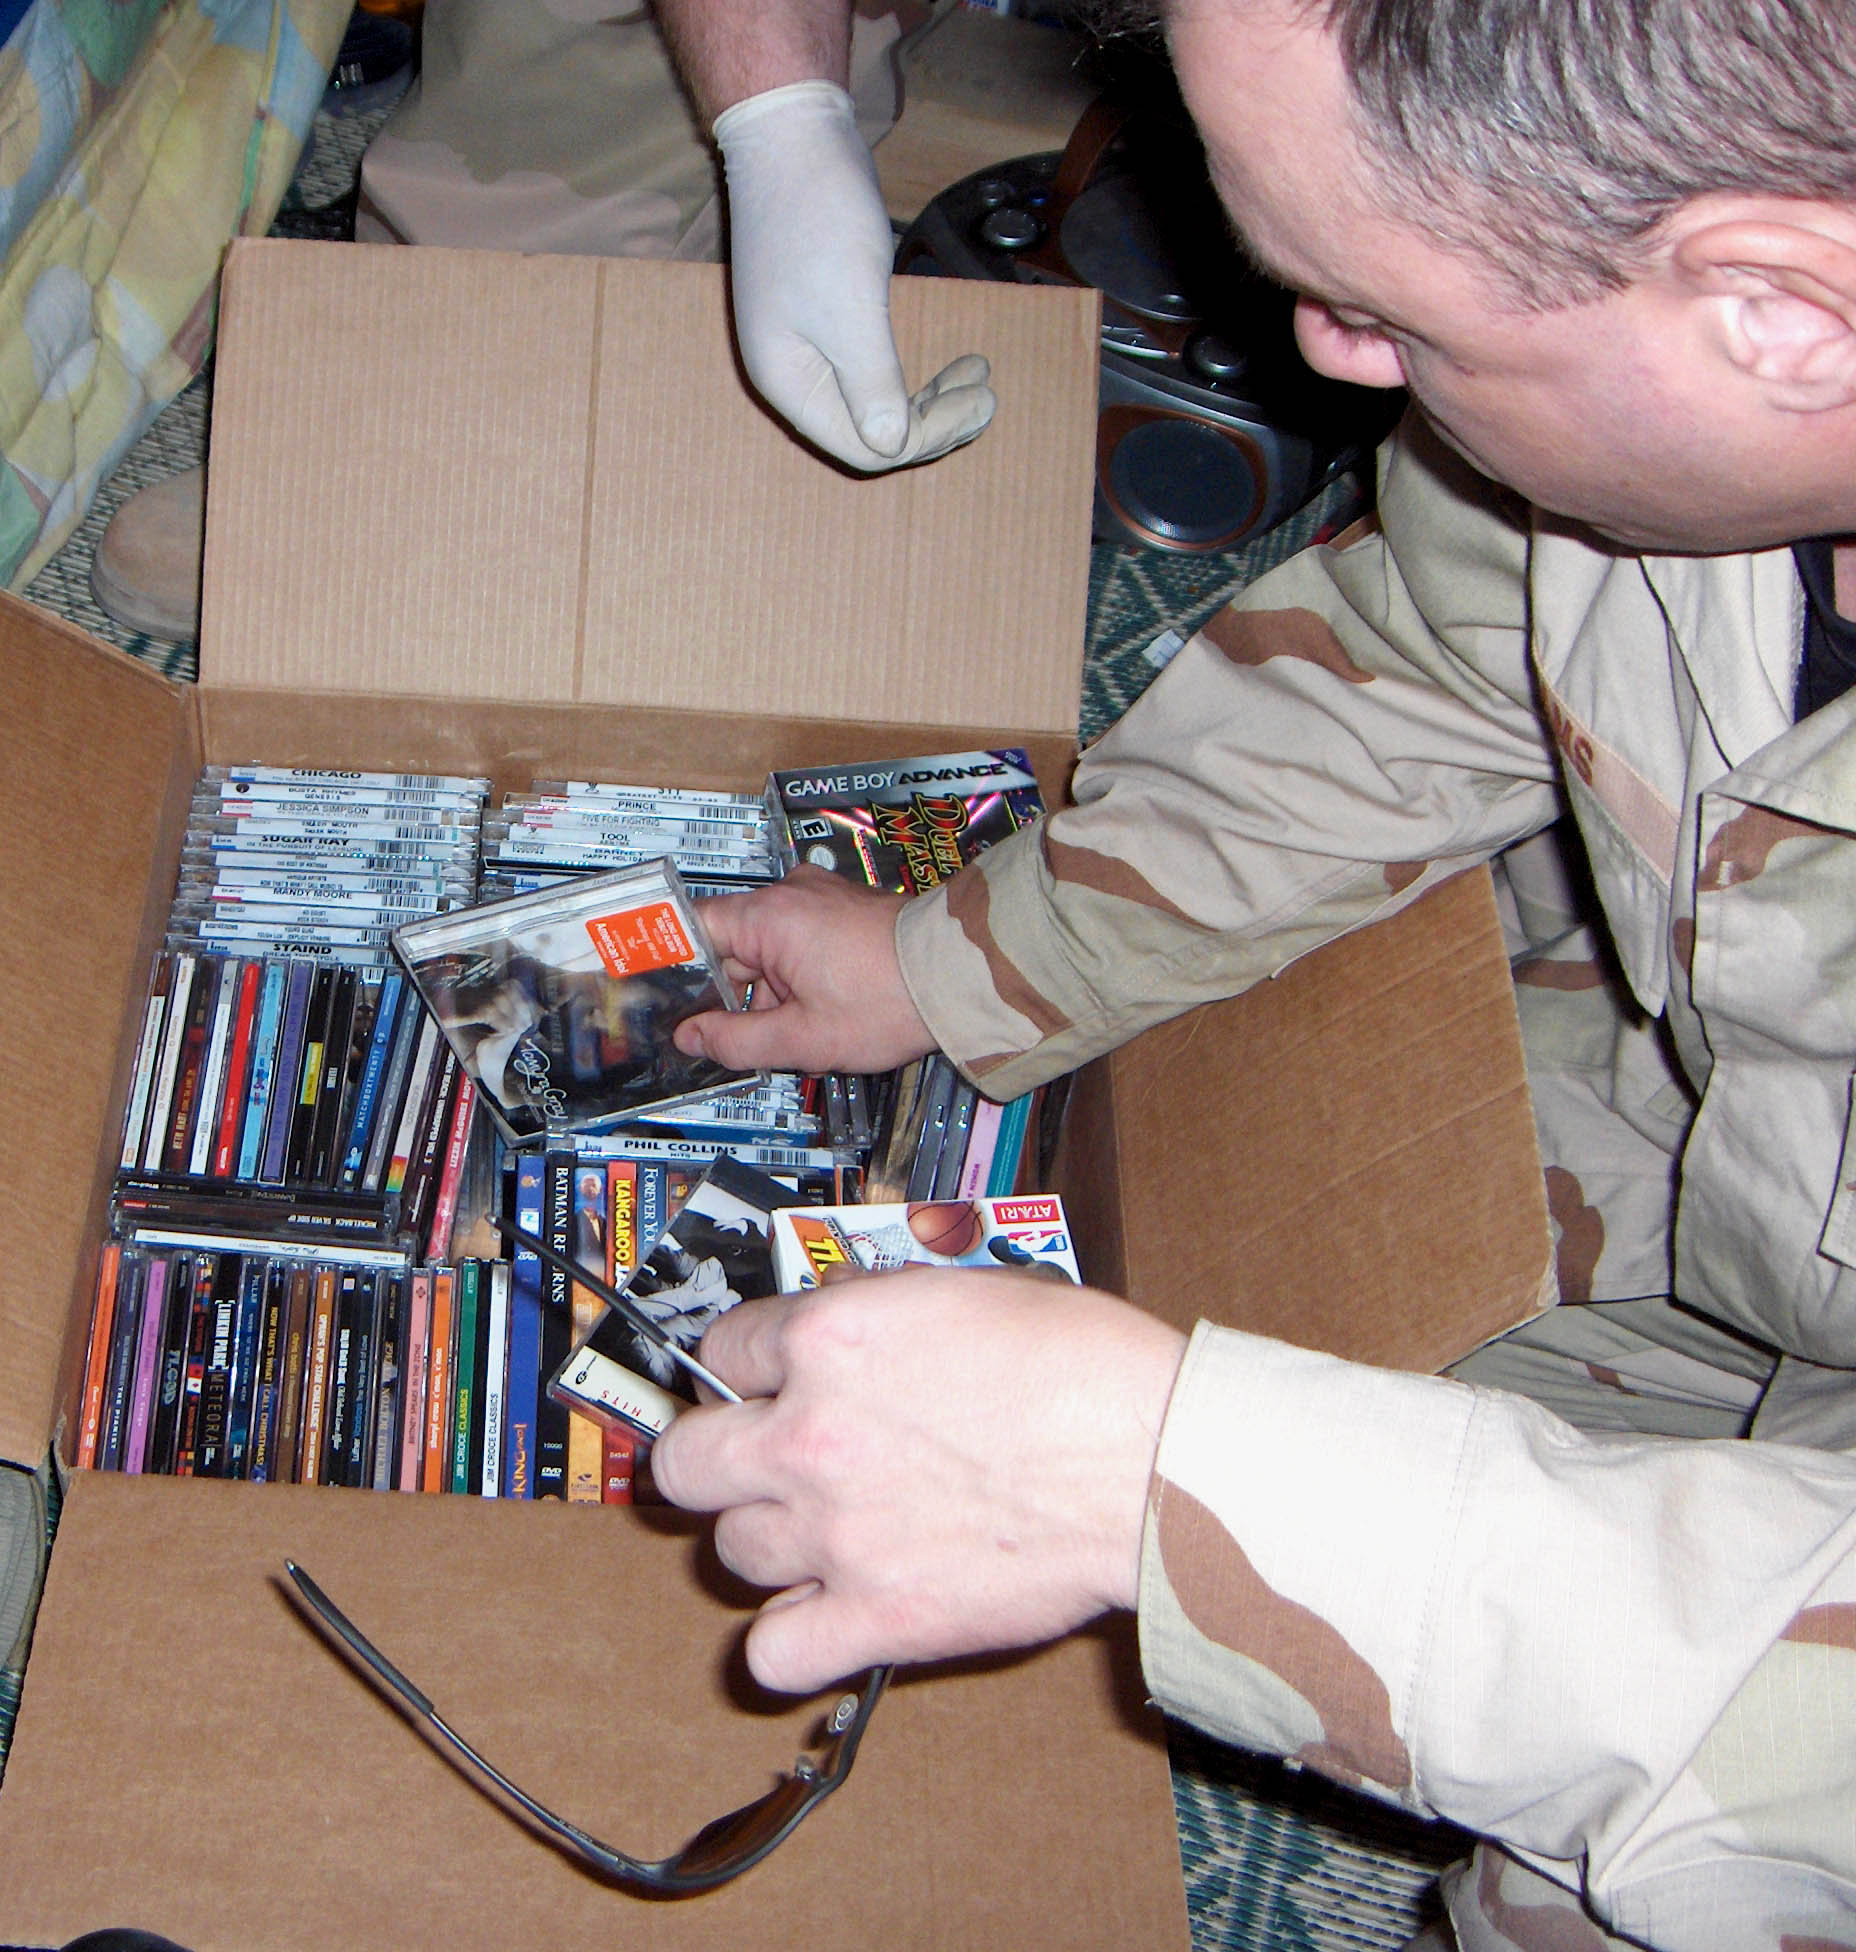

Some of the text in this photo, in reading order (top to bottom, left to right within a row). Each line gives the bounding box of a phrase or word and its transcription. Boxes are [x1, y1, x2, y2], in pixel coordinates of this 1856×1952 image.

[292, 769, 362, 779] CHICAGO
[786, 762, 1009, 798] GAME BOY ADVANCE
[276, 803, 319, 812] JESSICA
[322, 805, 369, 815] SIMPSON
[618, 800, 657, 810] PRINCE
[582, 814, 661, 827] FIVE FOR FIGHTING
[911, 790, 970, 875] DUEL
[261, 835, 350, 846] SUGAR RAY
[600, 832, 630, 842] TOOL
[273, 887, 352, 900] MANDY MOORE
[273, 943, 332, 955] STAIND
[595, 923, 619, 959] American
[613, 958, 629, 974] Idol
[513, 1038, 553, 1096] Tamyra
[544, 1088, 569, 1120] Gray
[449, 1142, 460, 1169] LIZZIE
[624, 1140, 737, 1155] PHIL COLLINS
[644, 1167, 658, 1220] FOREVER
[614, 1179, 631, 1261] KANGAROO
[1000, 1204, 1052, 1221] ATARI
[551, 1167, 569, 1303] BATMAN RERNS
[269, 1307, 278, 1327] NOW
[317, 1314, 327, 1345] OPRAH'S
[266, 1328, 276, 1356] THAT'S
[315, 1347, 325, 1363] POP
[264, 1357, 273, 1381] WHAT
[313, 1364, 324, 1383] STAR
[115, 1386, 123, 1405] THE
[261, 1389, 271, 1410] CALL
[409, 1390, 417, 1415] SPEARS
[602, 1390, 642, 1417] HITS
[203, 1373, 225, 1444] METEORA
[431, 1401, 440, 1421] crow
[111, 1408, 120, 1451] PIANIST
[407, 1417, 416, 1444] BRITNEY
[429, 1422, 440, 1448] sheryl
[456, 1389, 469, 1479] JIM CROCE CLASSICS
[486, 1393, 498, 1483] JIM CROCE CLASSICS
[511, 1450, 528, 1493] KING
[541, 1466, 563, 1478] DVD
[608, 1477, 630, 1489] DVD
